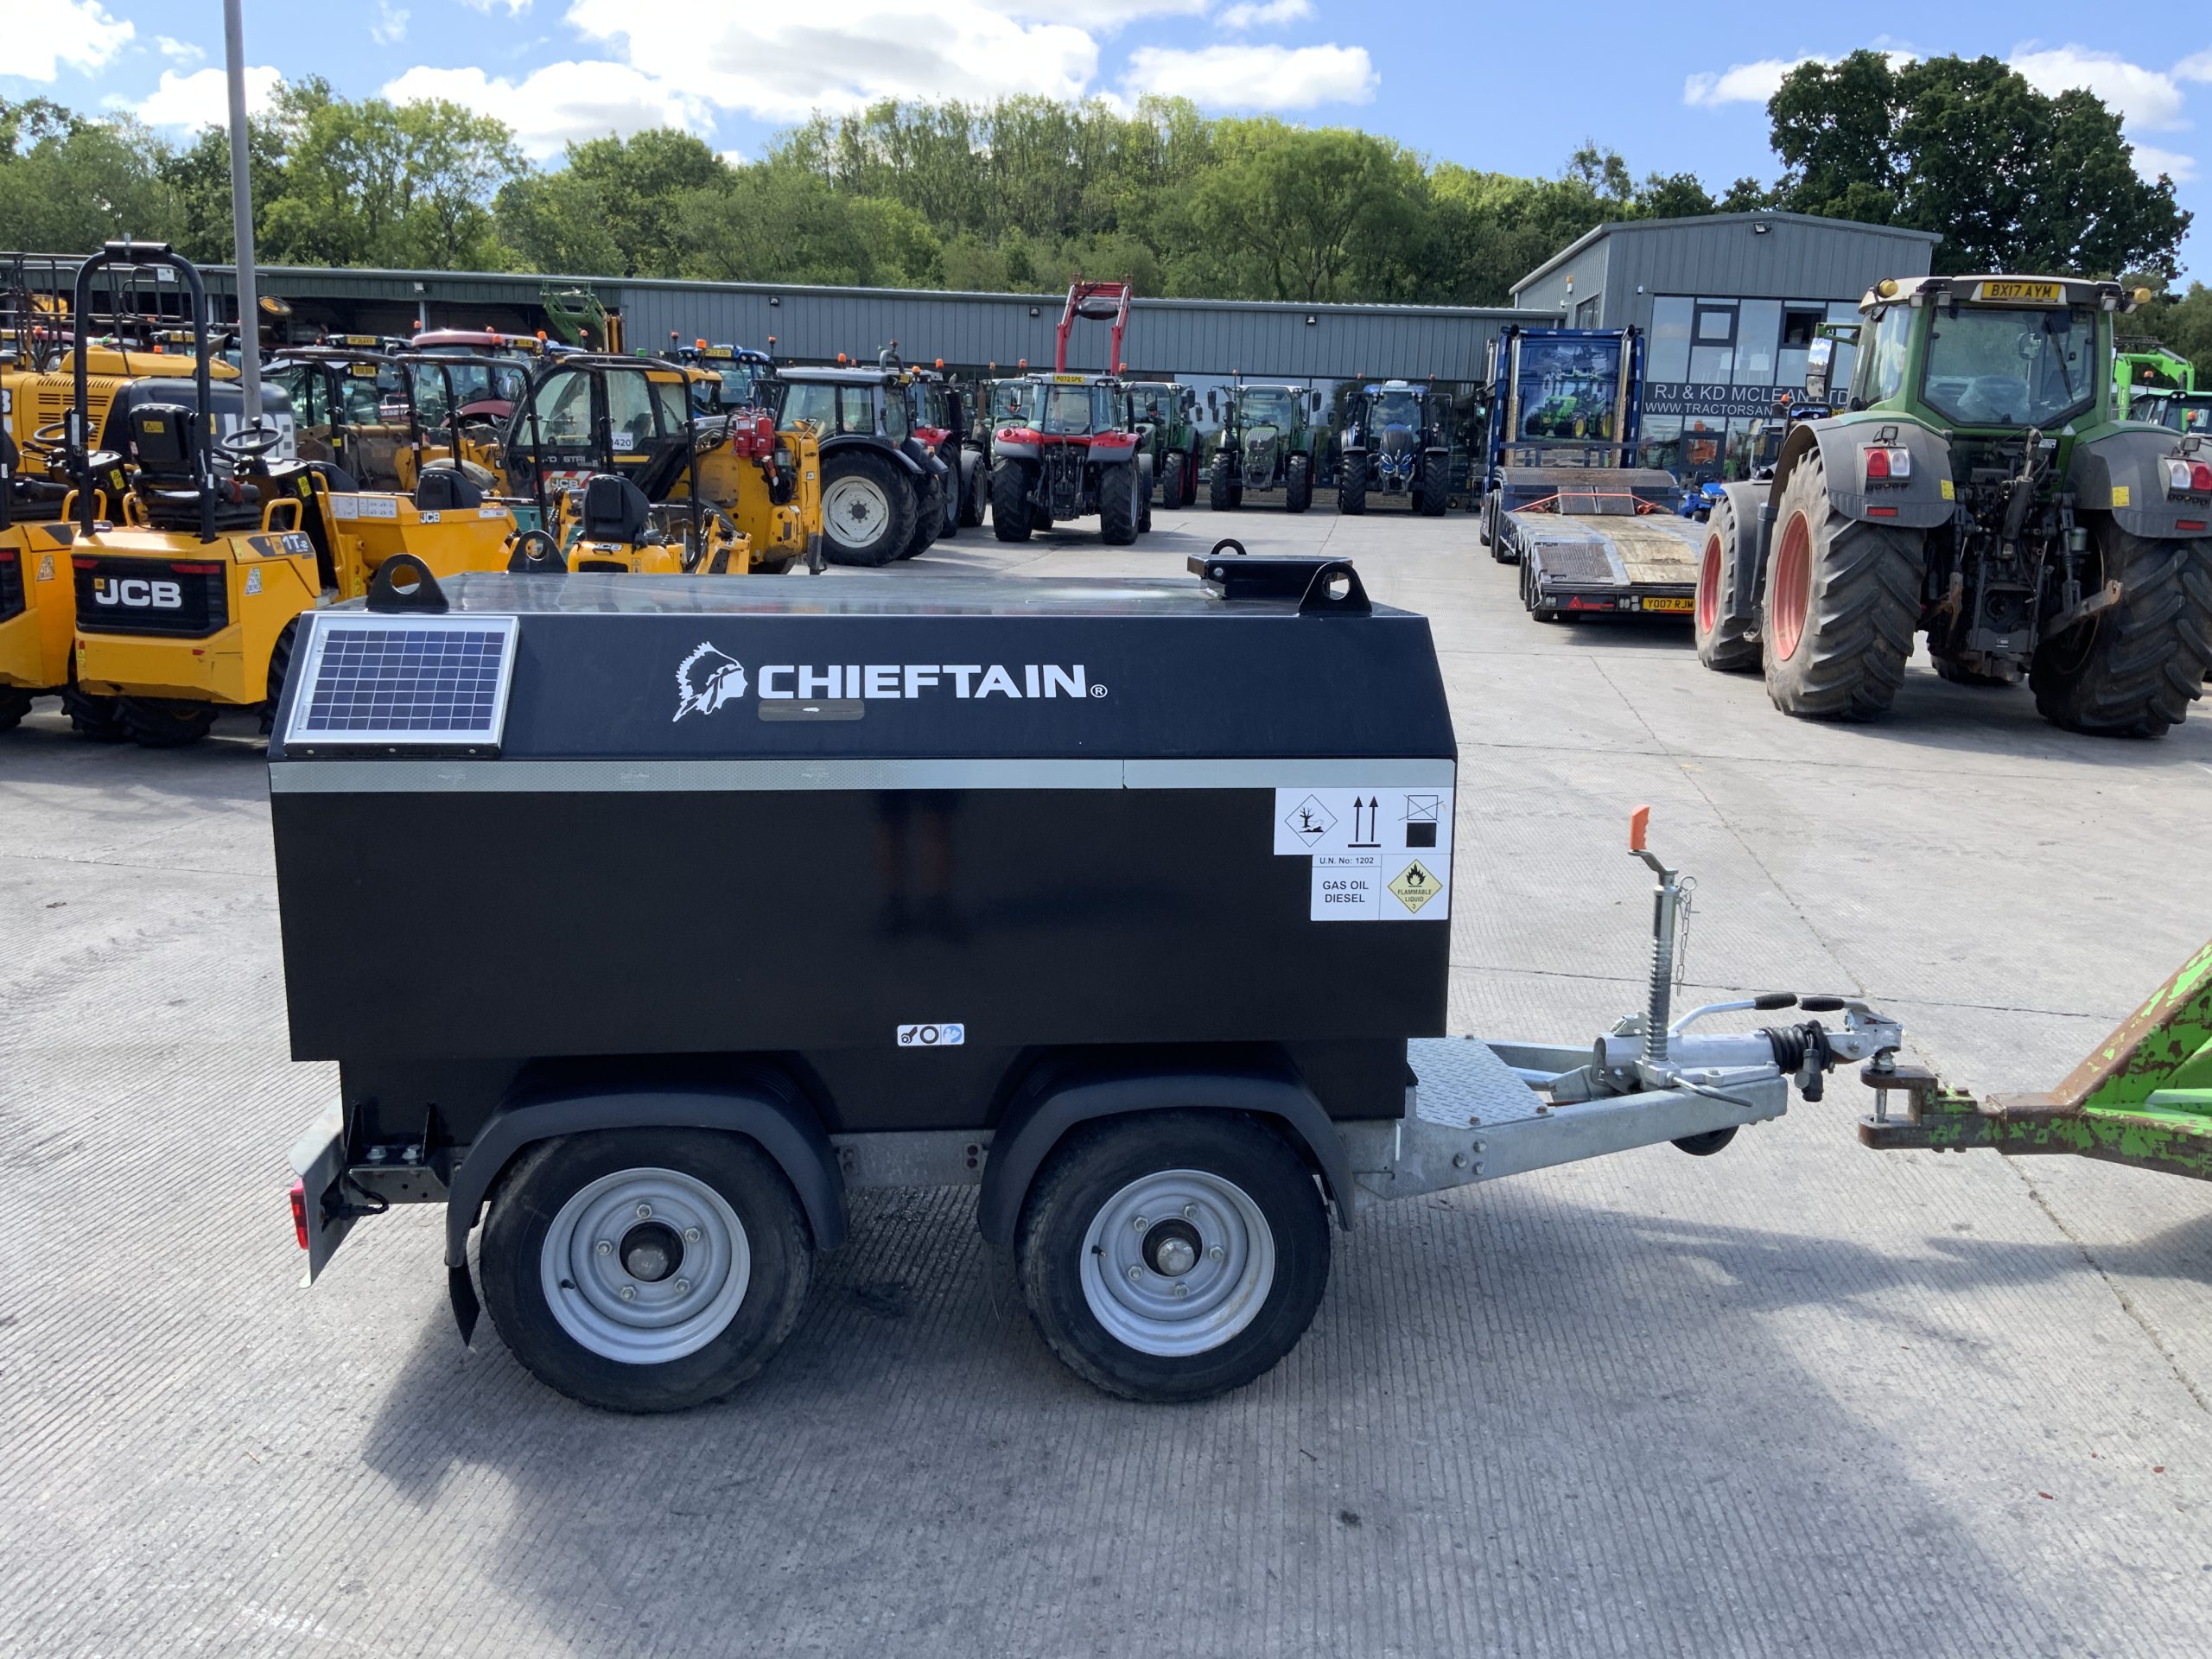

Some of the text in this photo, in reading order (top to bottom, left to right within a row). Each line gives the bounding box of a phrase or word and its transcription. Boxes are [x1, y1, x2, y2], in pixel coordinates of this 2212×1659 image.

[1991, 284, 2051, 297] BX17 AYM
[1654, 385, 1677, 399] RJ
[1682, 385, 1694, 399] &
[1700, 386, 1726, 401] KD
[1732, 387, 1808, 403] MCLEAN
[1644, 402, 1772, 416] WWW.TRACTORSAN
[552, 480, 579, 488] JCB
[420, 512, 440, 524] JCB
[95, 579, 181, 607] JCB
[1648, 600, 1672, 608] YO07
[758, 664, 1086, 698] CHIEFTAIN
[1322, 880, 1369, 890] GAS OIL
[1325, 893, 1365, 903] DIESEL
